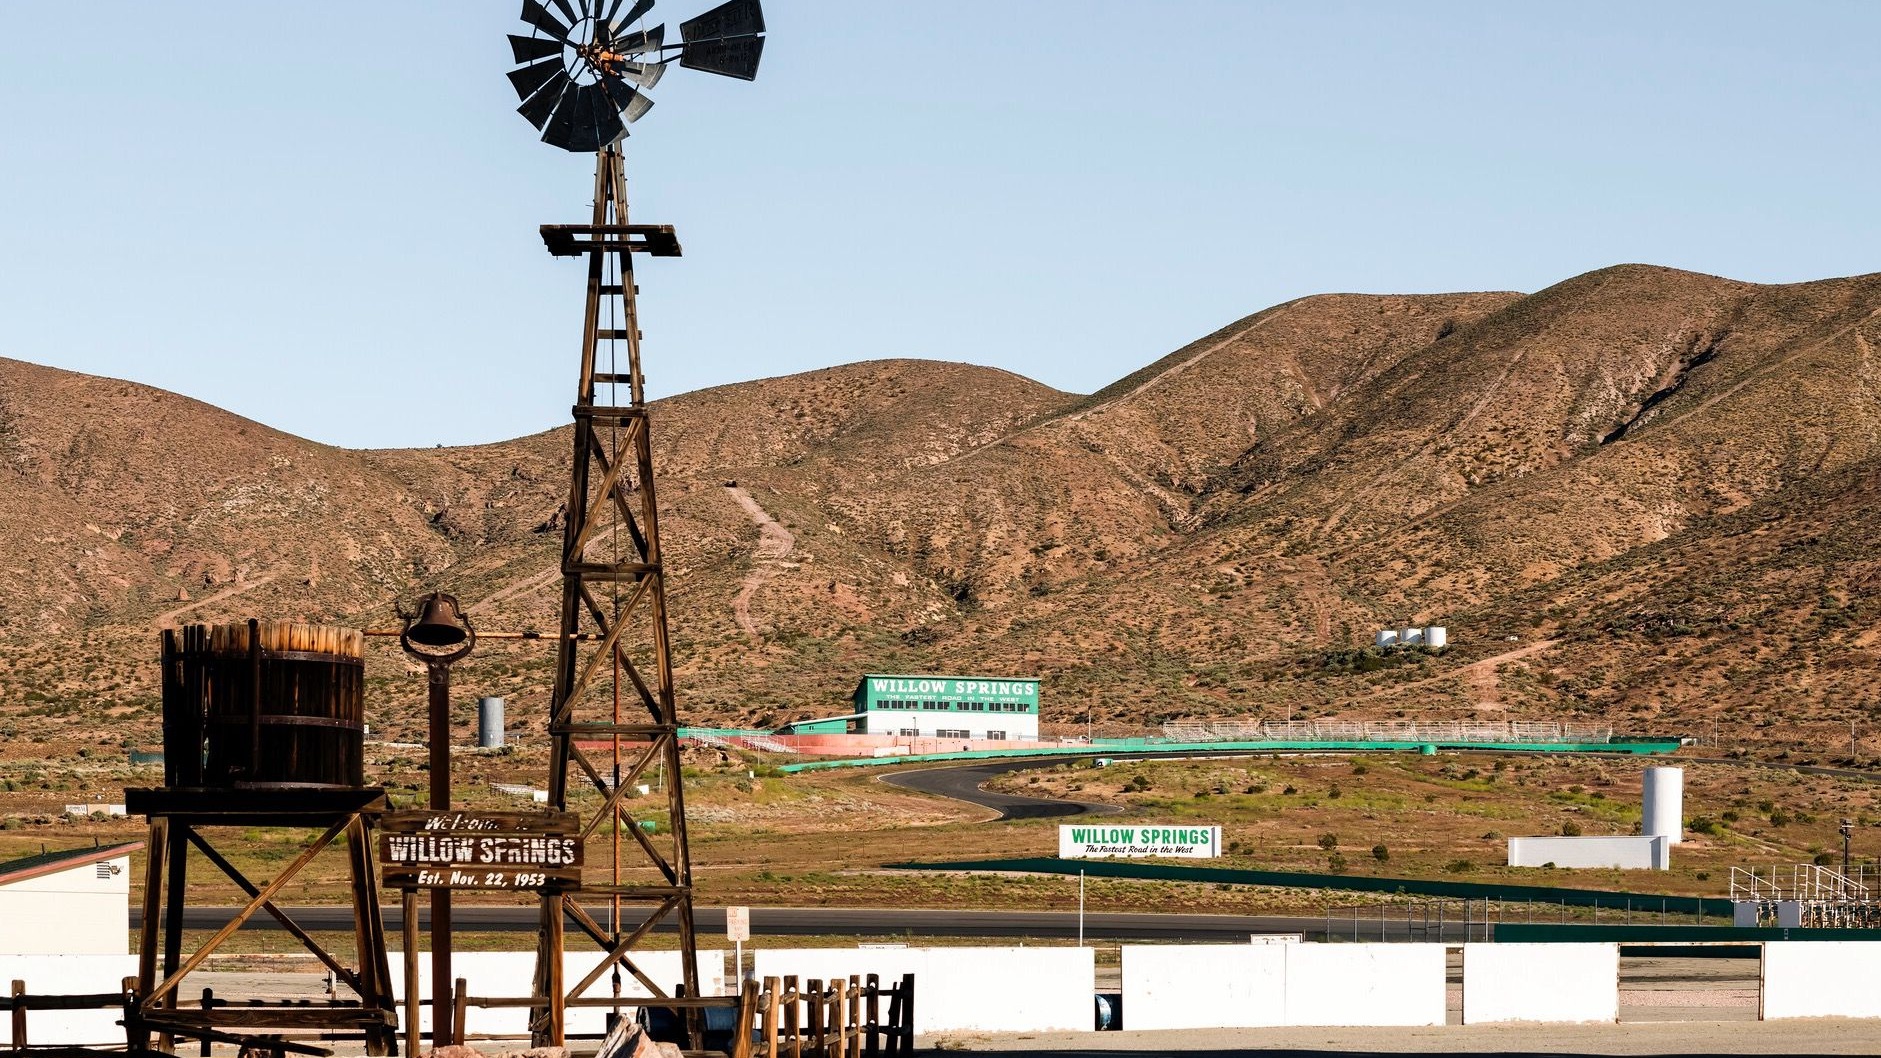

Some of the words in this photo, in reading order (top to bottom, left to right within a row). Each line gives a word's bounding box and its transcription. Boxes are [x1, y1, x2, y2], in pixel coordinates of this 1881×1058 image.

[872, 680, 947, 693] WILLOW
[955, 681, 1034, 695] SPRINGS
[1072, 829, 1134, 844] WILLOW
[1141, 829, 1209, 844] SPRINGS
[389, 837, 474, 863] WILLOW
[1128, 845, 1148, 853] Road
[1150, 845, 1158, 853] in
[1160, 845, 1173, 853] the
[418, 871, 443, 885] Est.
[450, 871, 478, 885] Nov.
[485, 873, 507, 887] 22,
[514, 873, 545, 886] 1953
